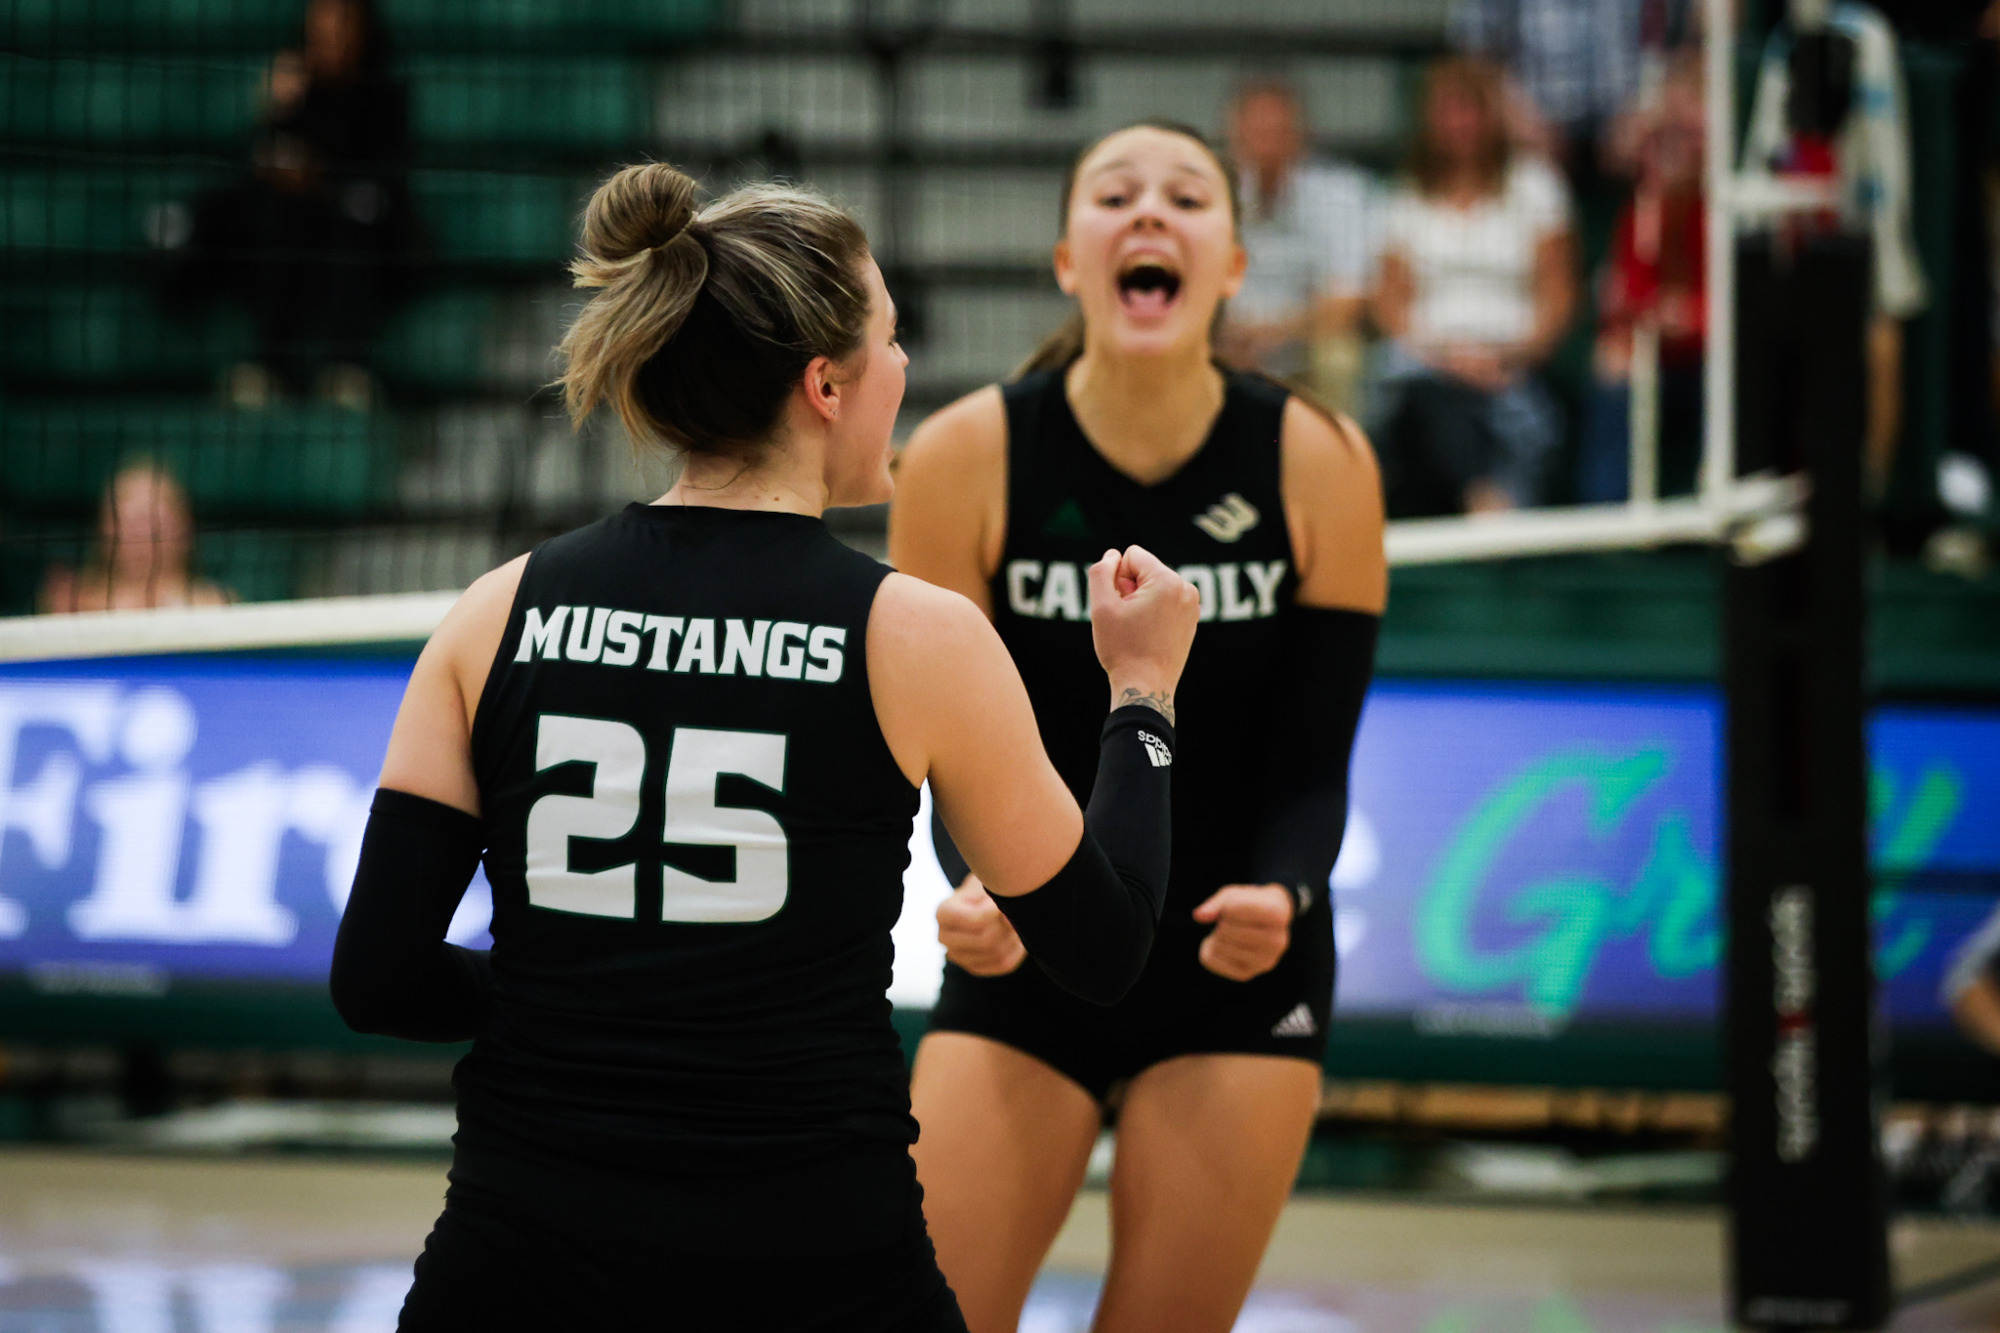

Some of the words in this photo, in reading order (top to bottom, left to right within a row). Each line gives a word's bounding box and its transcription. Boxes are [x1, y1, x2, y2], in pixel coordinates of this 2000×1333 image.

[1006, 558, 1092, 622] CA
[1174, 559, 1288, 623] OLY
[514, 604, 847, 683] MUSTANGS
[525, 713, 790, 923] 25
